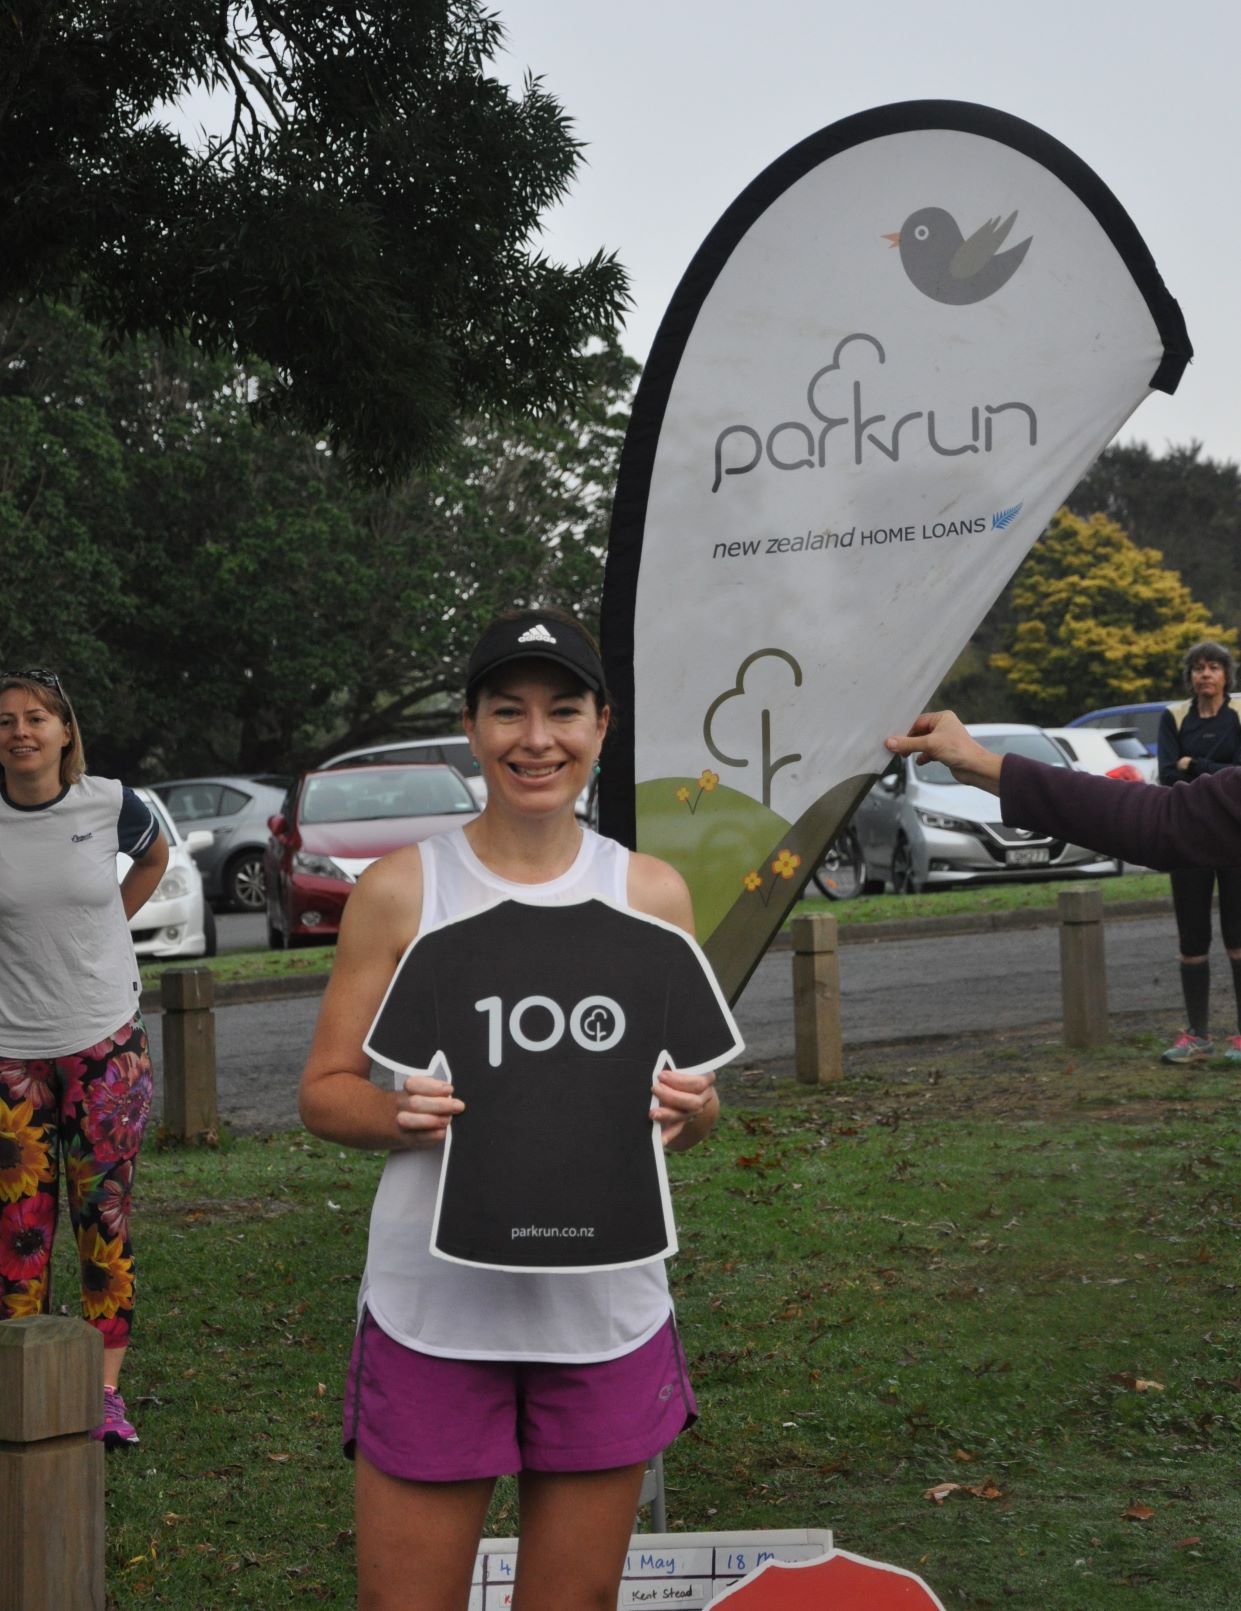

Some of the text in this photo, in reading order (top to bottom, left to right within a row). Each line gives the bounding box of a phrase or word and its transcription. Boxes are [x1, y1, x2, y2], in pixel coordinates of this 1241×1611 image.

[711, 332, 1037, 493] parkrun
[712, 517, 986, 559] new zealand HOME LOANS
[474, 994, 626, 1068] 100
[511, 1224, 595, 1240] parkrun.co.nz
[640, 1554, 675, 1574] May
[727, 1554, 746, 1570] 18
[662, 1584, 693, 1599] Stead
